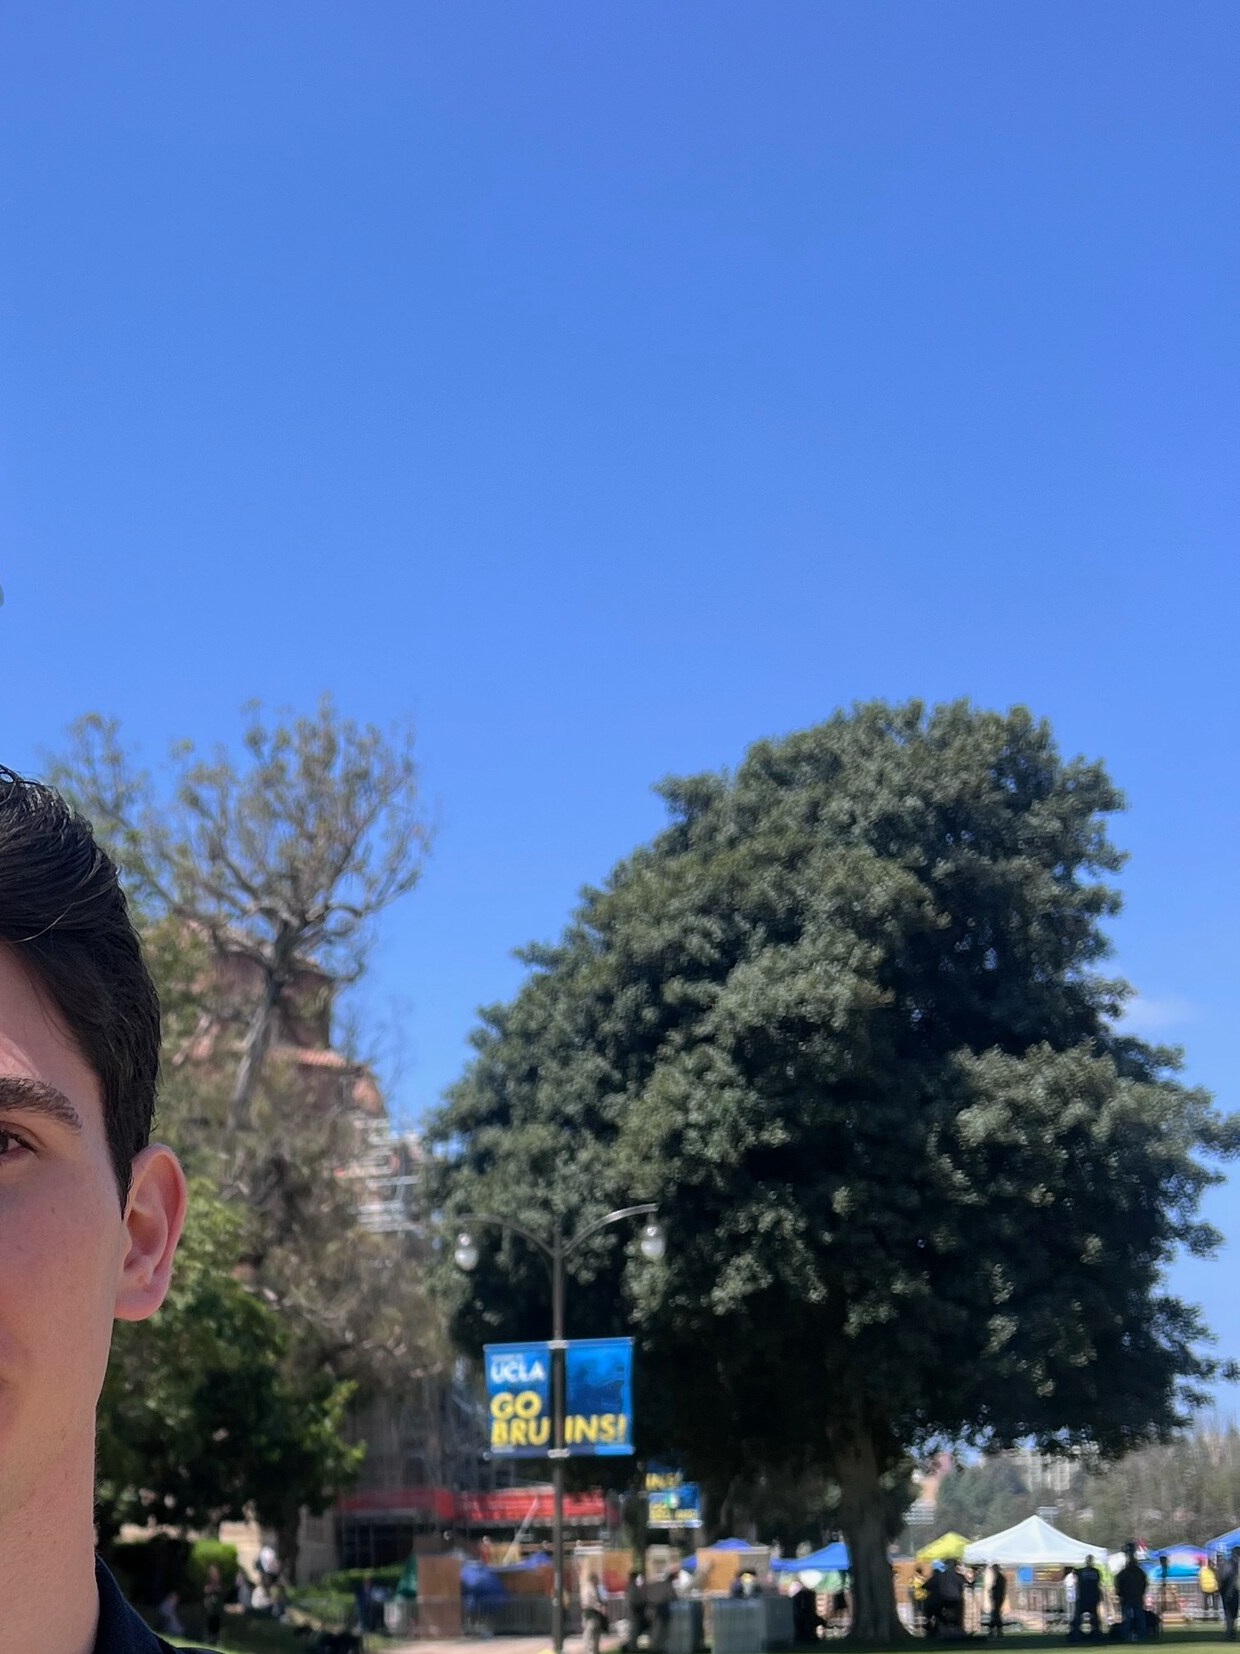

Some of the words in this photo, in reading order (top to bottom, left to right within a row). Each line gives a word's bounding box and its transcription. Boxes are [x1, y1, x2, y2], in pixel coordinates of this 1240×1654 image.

[490, 1359, 545, 1384] UCLA
[490, 1390, 542, 1420] GO
[491, 1416, 551, 1446] BRU
[564, 1413, 627, 1444] INS!
